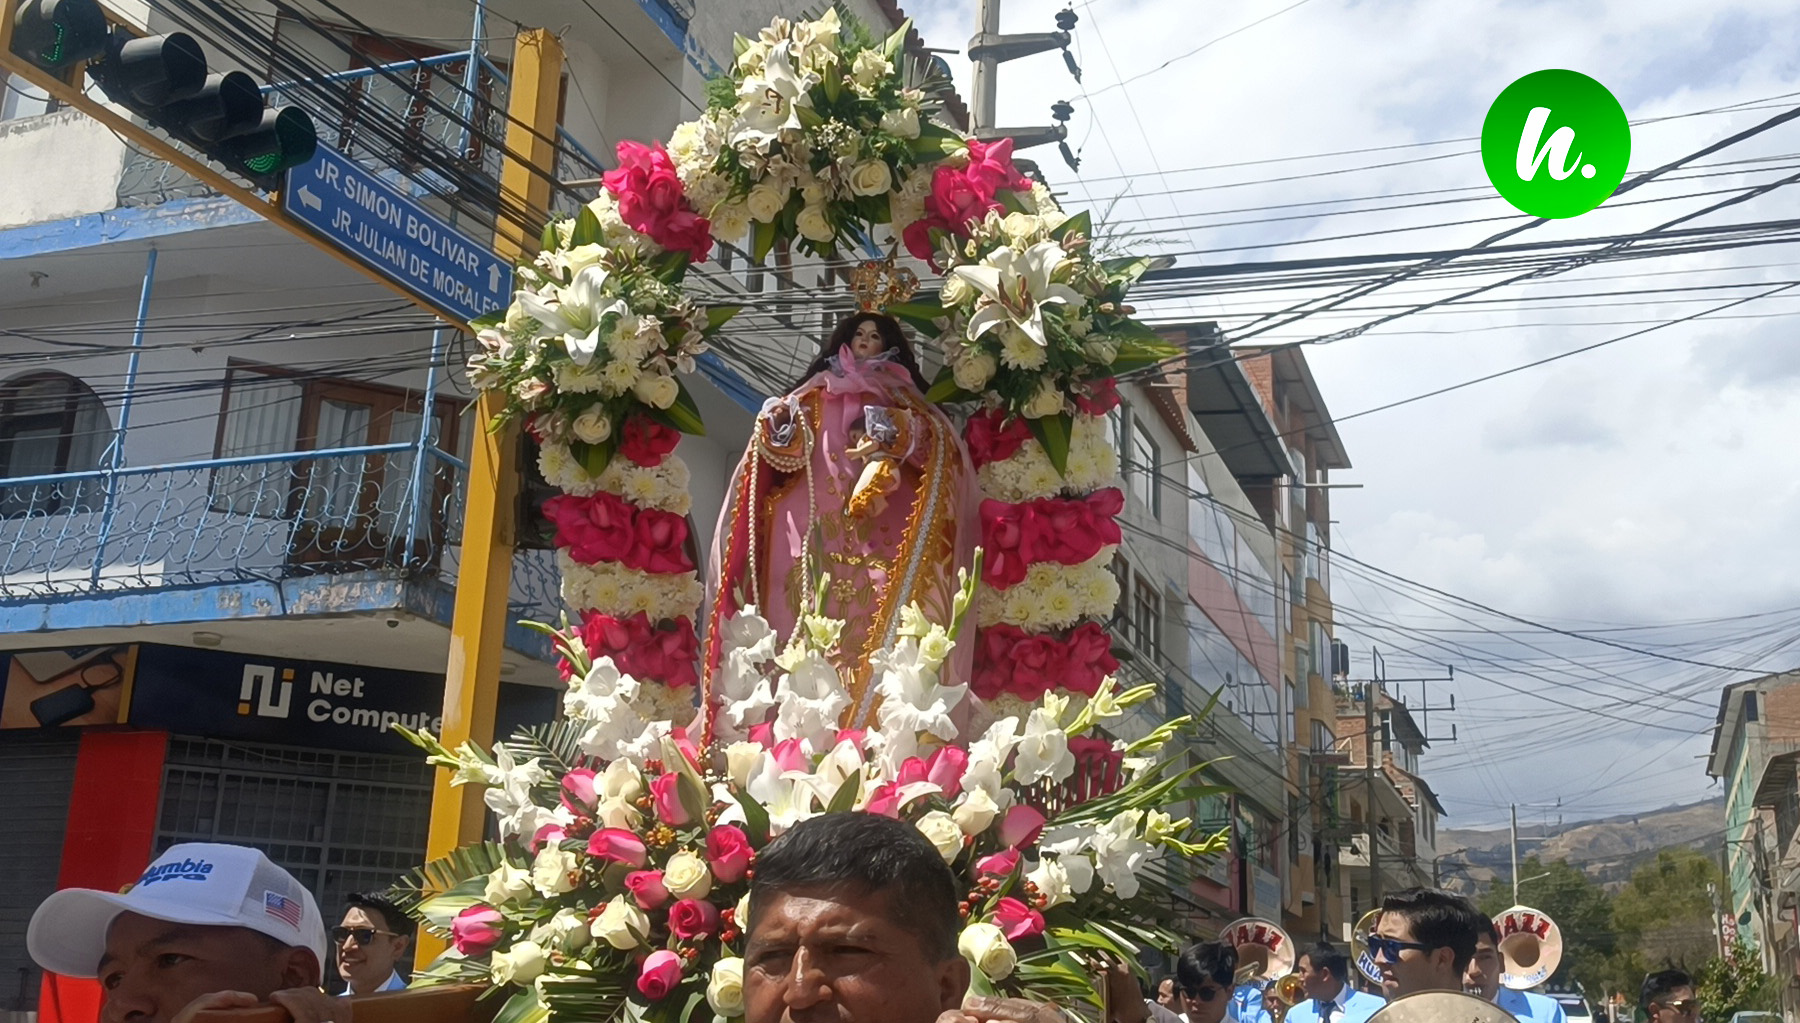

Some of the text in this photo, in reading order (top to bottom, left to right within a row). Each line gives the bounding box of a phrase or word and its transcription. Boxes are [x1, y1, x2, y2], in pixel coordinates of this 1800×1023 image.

[406, 215, 479, 277] BOLIVAR
[410, 254, 429, 284] DE
[310, 671, 365, 698] Net
